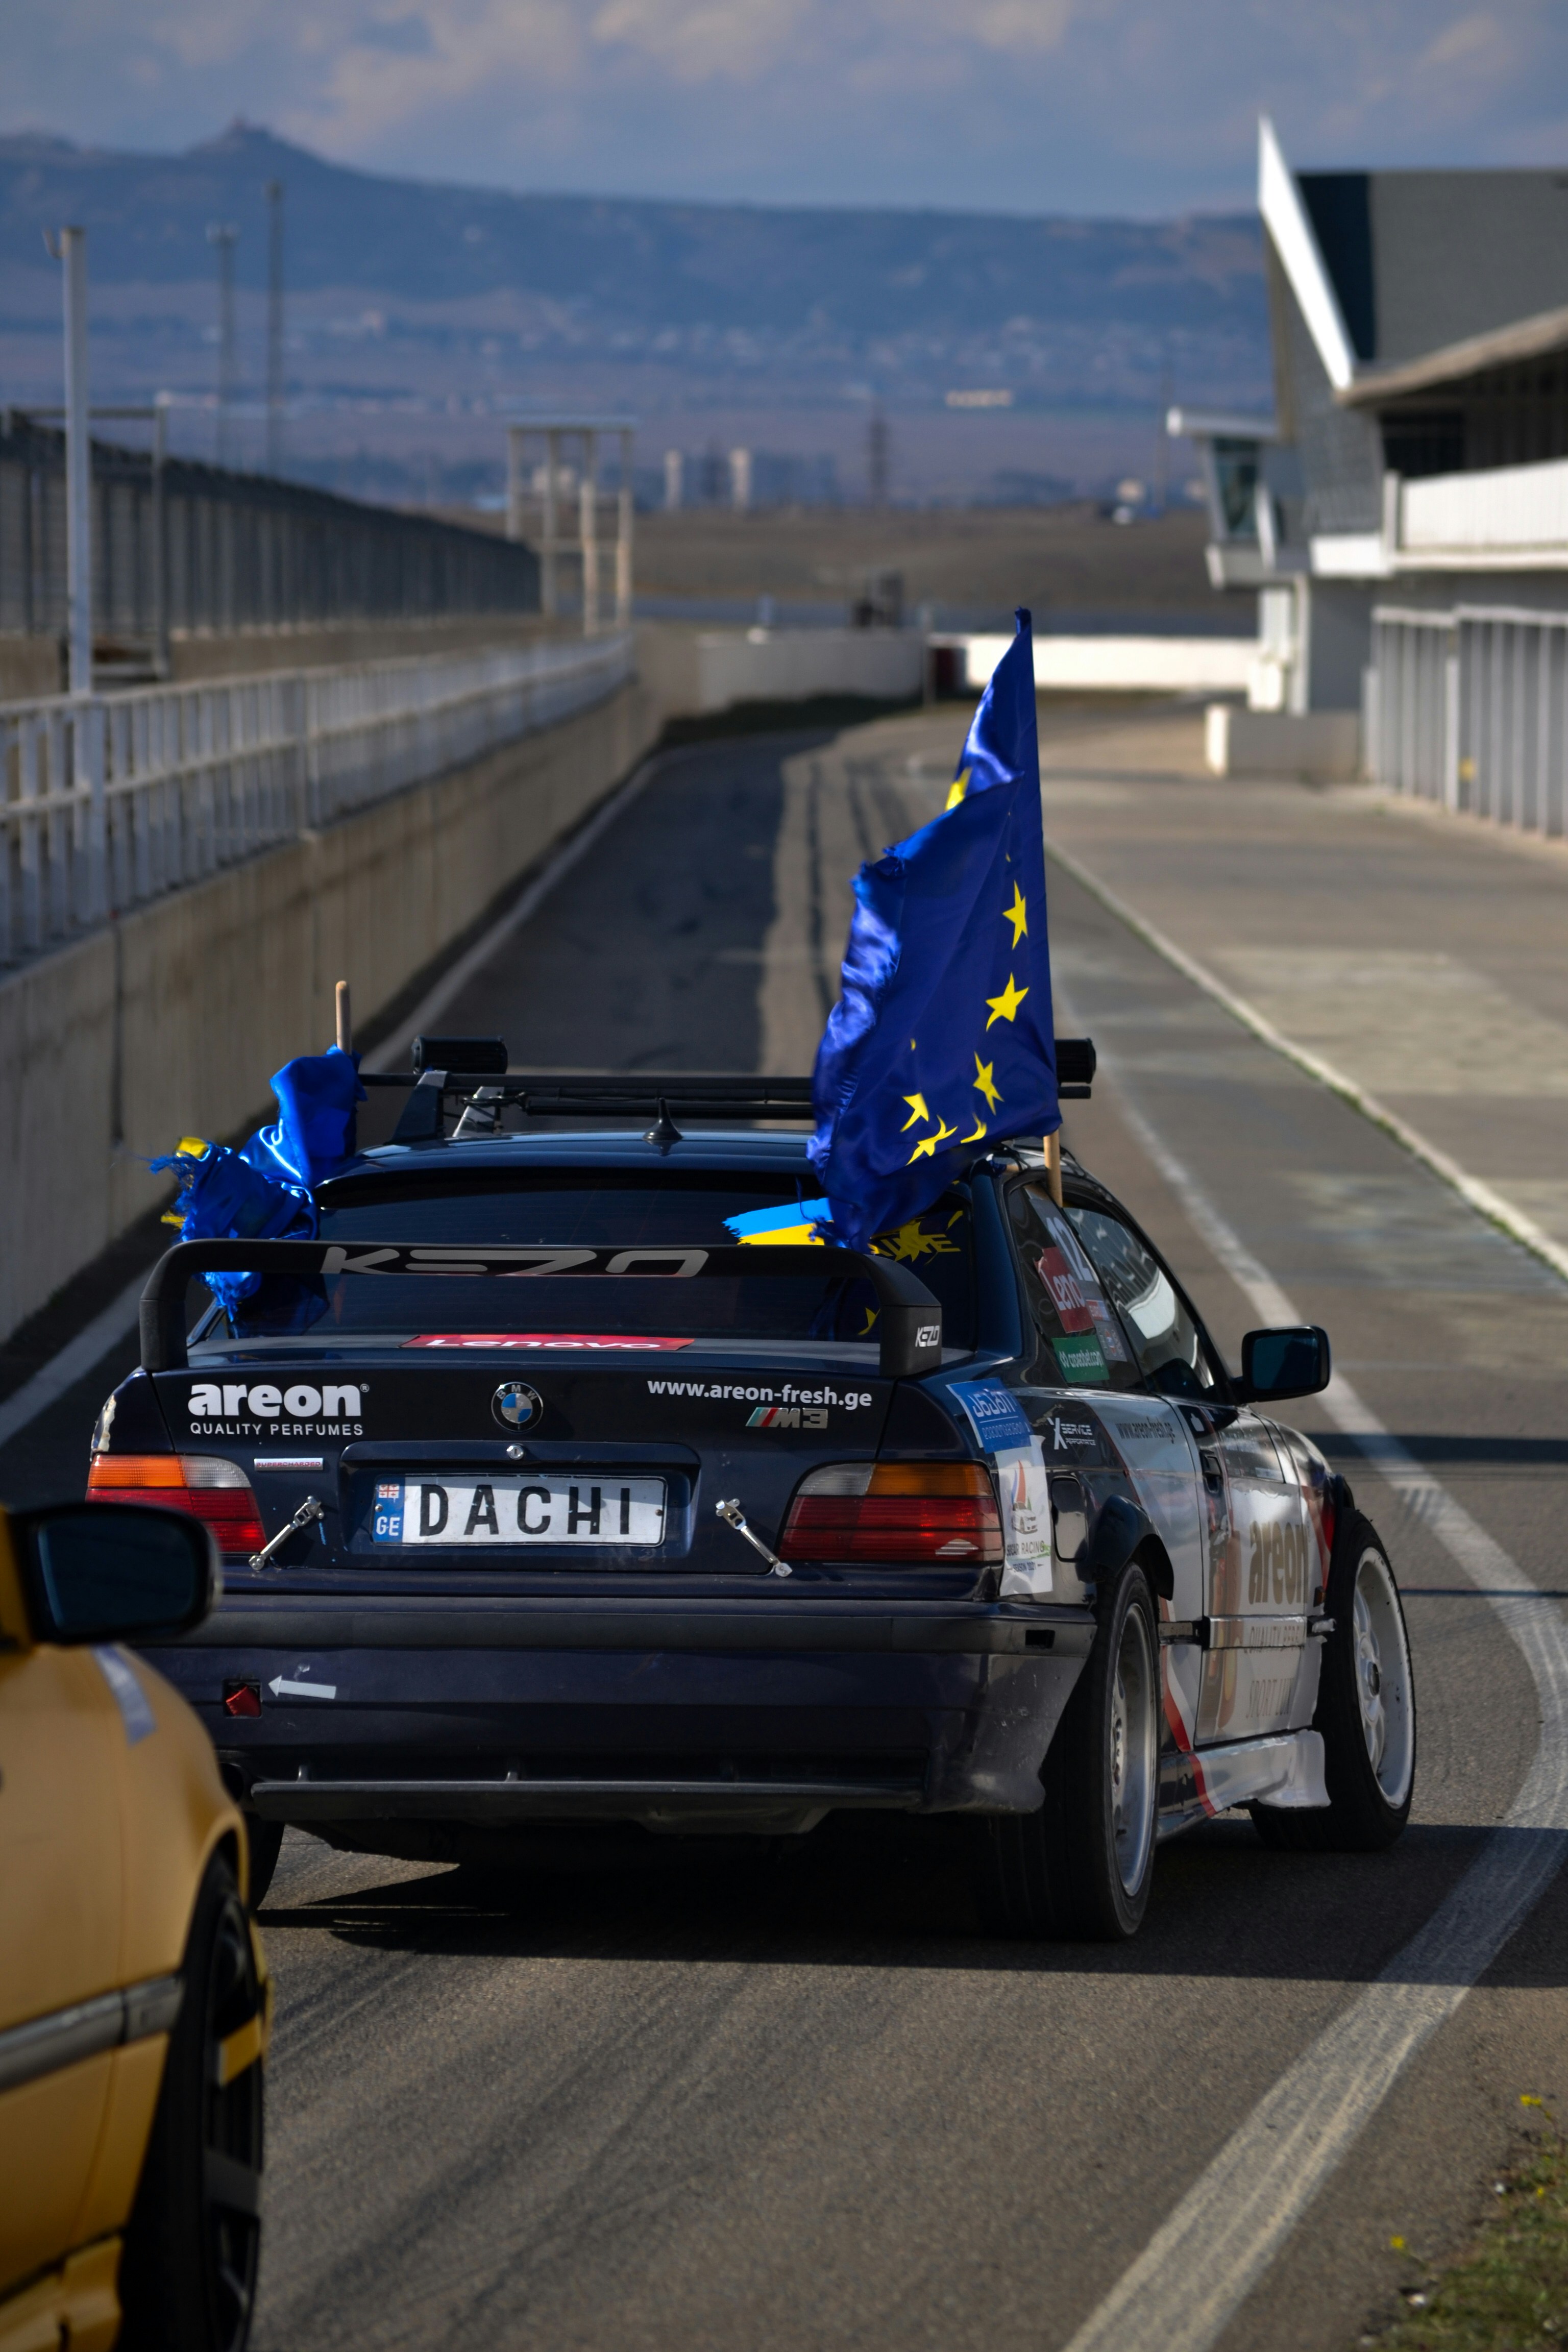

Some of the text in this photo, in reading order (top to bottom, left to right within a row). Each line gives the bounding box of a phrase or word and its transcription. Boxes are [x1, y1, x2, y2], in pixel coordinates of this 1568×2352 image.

[426, 1339, 660, 1349] Lenovo
[497, 1384, 537, 1400] BMW
[647, 1381, 872, 1410] www.areon-fresh.ge
[190, 1423, 363, 1436] QUALITY PERFUMES
[1061, 1424, 1093, 1435] SERVICE
[420, 1484, 630, 1536] DACHI
[376, 1516, 400, 1536] GE
[1022, 1540, 1045, 1555] RACING
